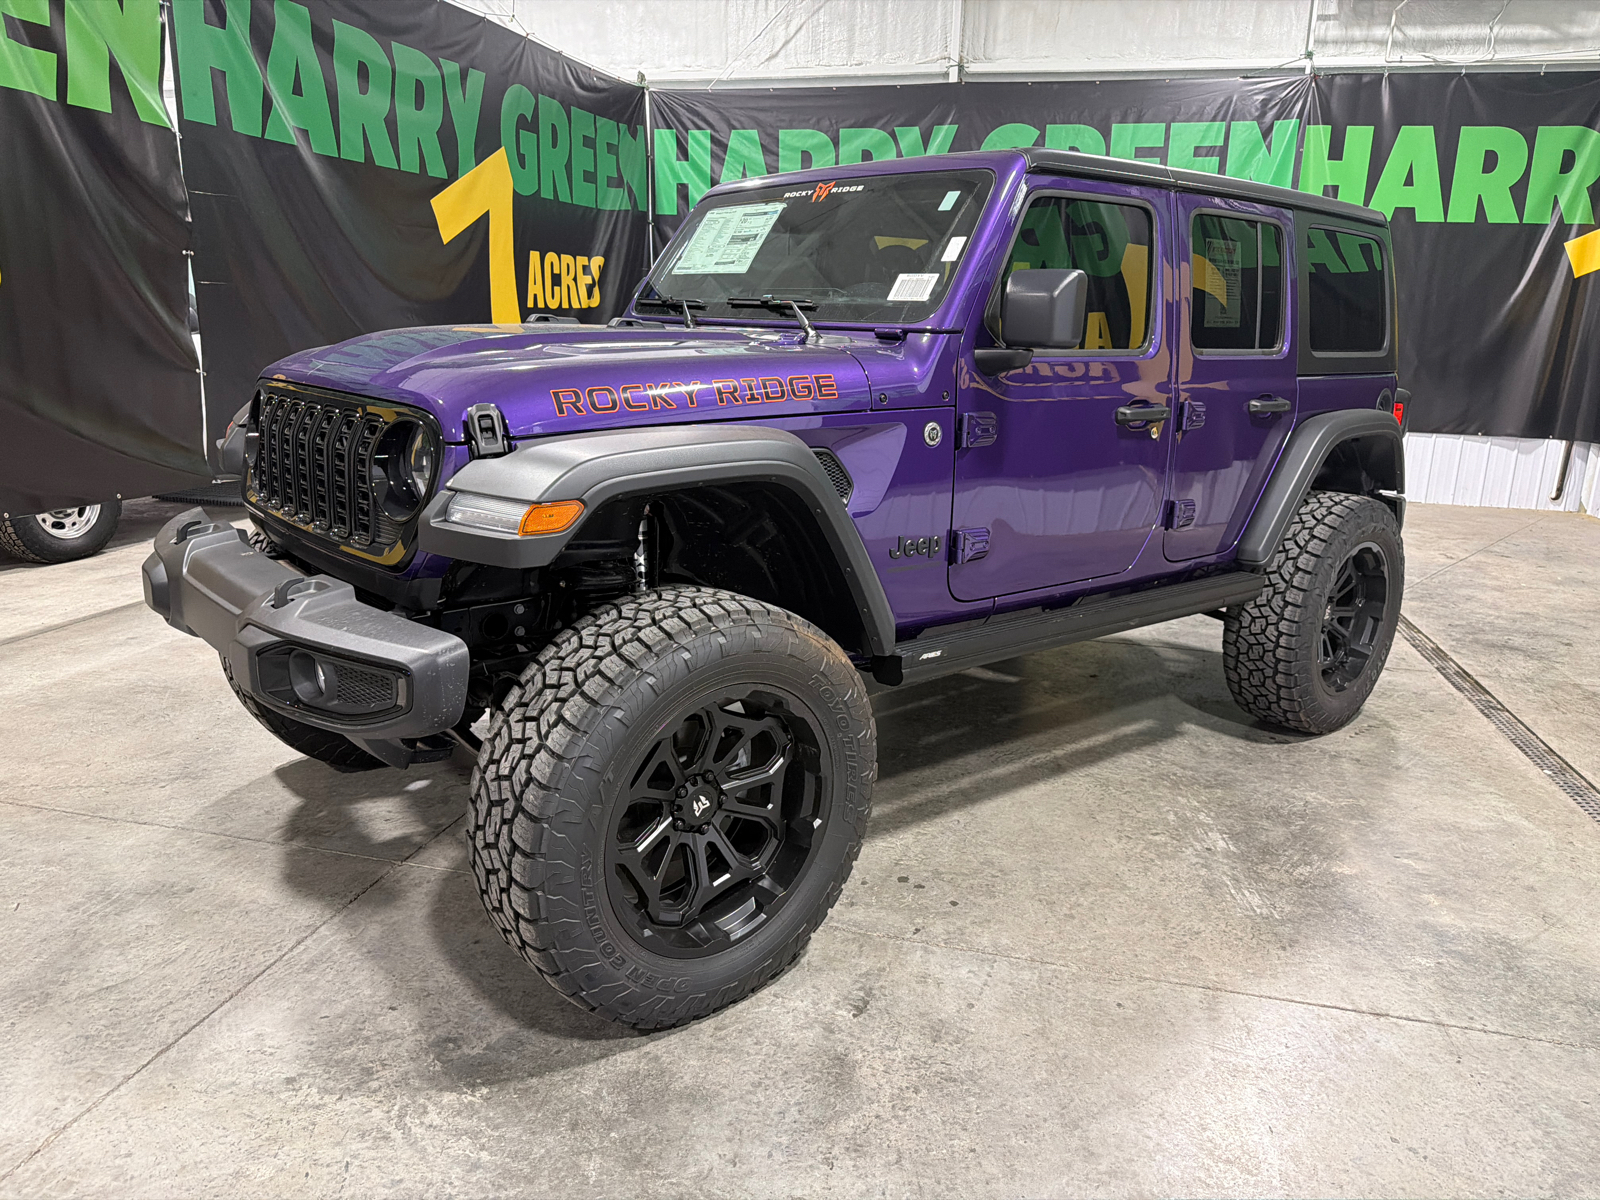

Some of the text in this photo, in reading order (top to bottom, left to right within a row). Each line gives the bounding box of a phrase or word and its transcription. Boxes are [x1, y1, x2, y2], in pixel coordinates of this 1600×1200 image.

[172, 0, 647, 211] HARRY GREEN
[783, 185, 864, 198] ROCKY RIDGE
[527, 250, 605, 310] ACRES
[550, 374, 838, 417] ROCKY RIDGE
[889, 535, 941, 559] Jeep
[808, 673, 851, 733] TOYO
[842, 733, 859, 825] TIRES
[579, 842, 627, 971] COUNTRY
[624, 964, 694, 993] OPEN
